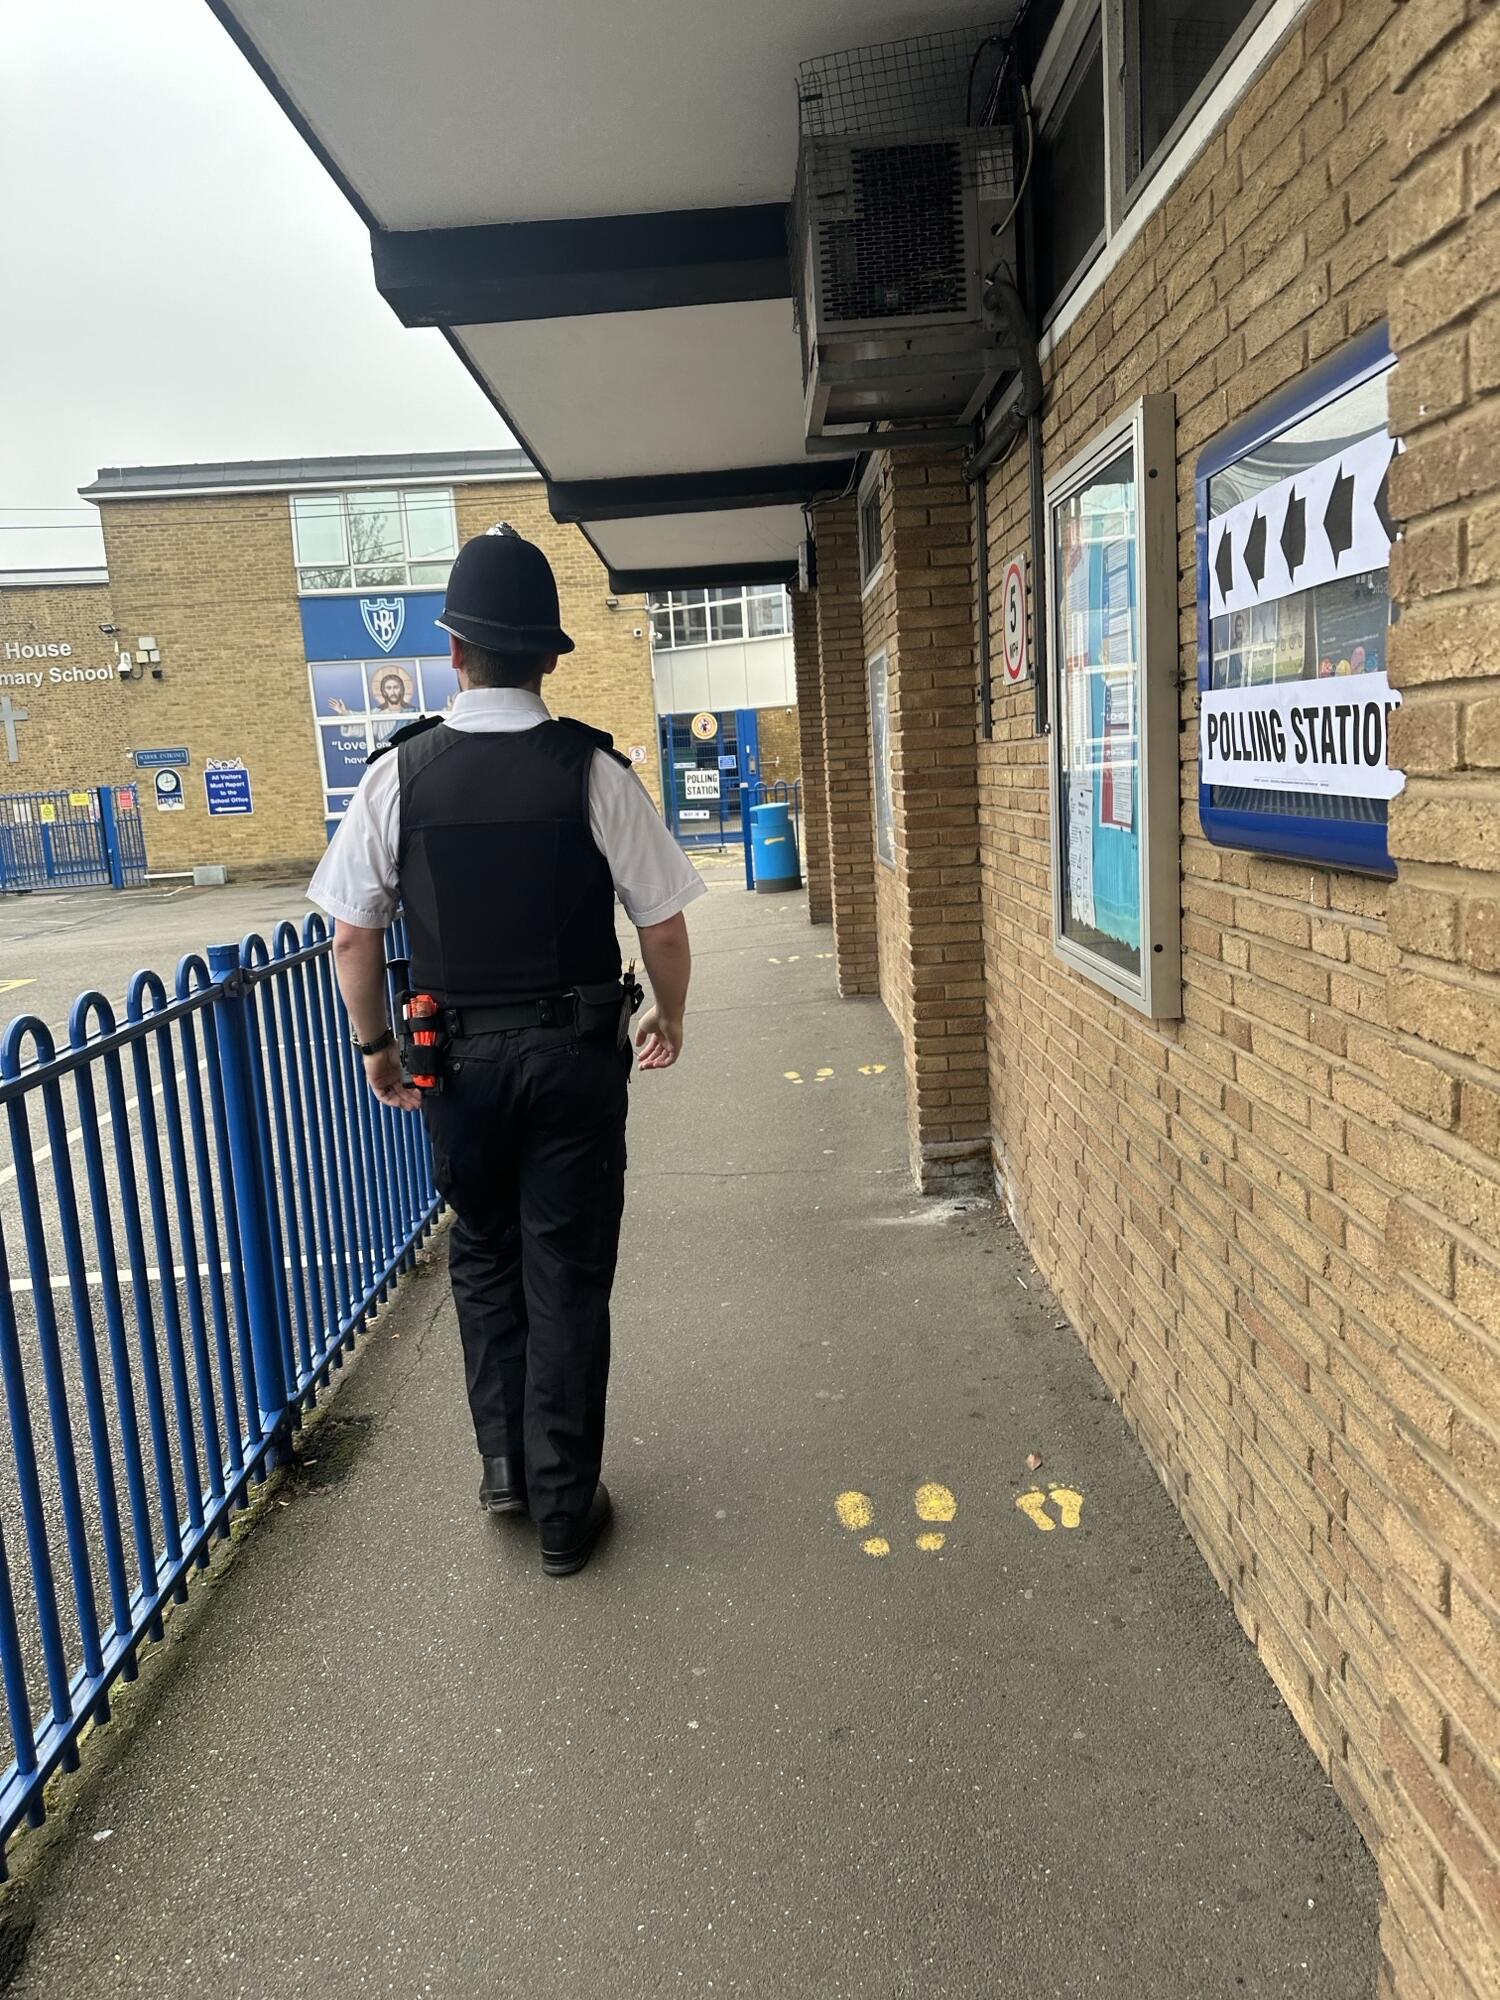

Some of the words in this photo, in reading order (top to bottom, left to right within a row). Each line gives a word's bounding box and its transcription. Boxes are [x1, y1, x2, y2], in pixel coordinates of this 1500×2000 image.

[1010, 584, 1017, 633] 5
[5, 642, 72, 659] House
[1009, 640, 1019, 659] MPH
[0, 671, 43, 688] mary
[49, 664, 114, 682] School
[1207, 708, 1287, 763] POLLING
[687, 774, 718, 784] POLLING
[687, 786, 719, 796] STATION
